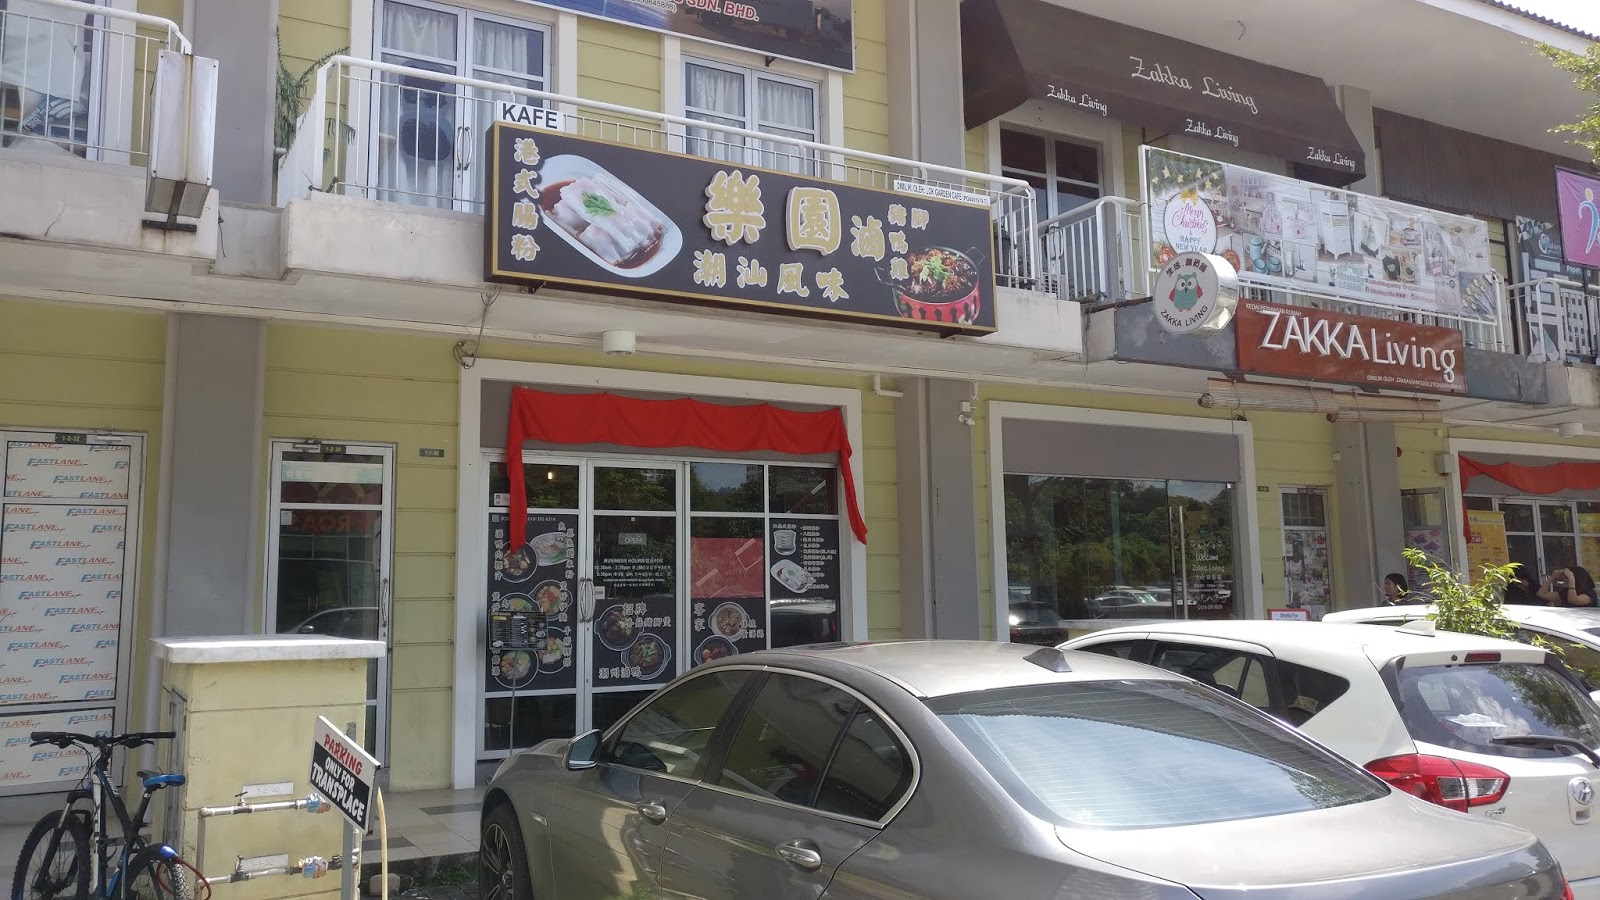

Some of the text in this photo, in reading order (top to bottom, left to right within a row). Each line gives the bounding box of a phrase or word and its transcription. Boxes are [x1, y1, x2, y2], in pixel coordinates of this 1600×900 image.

[723, 4, 759, 21] BHD.
[1129, 56, 1258, 114] Zakka Living
[1047, 84, 1108, 117] Zakka Living
[502, 102, 558, 130] KAFE
[1184, 118, 1239, 147] Zakka Living
[1306, 146, 1356, 172] Zakka Living
[702, 169, 842, 256] 樂園
[1179, 235, 1202, 245] HAPPY
[1175, 242, 1190, 251] NEW
[692, 249, 850, 302] 潮汕風味
[1160, 303, 1209, 328] ZAKKA LIVING
[1258, 308, 1456, 383] ZAKKA Living
[61, 434, 81, 442] 1-2-32
[27, 458, 82, 466] FASTLANE
[53, 475, 107, 483] FASTLANE
[66, 508, 119, 516] FASTLANE
[3, 524, 57, 532] FASTLANE
[29, 541, 84, 549] FASTLANE
[55, 558, 109, 566] FASTLANE
[18, 591, 72, 599] FASTLANE
[44, 607, 98, 616] FASTLANE
[6, 641, 61, 651] FASTLANE
[33, 657, 87, 667] FASTLANE
[58, 673, 112, 683] FASTLANE
[0, 692, 50, 701] FASTLANE
[32, 750, 86, 762] FASTLANE
[324, 733, 363, 776] PARKING
[325, 756, 356, 793] ONLY FOR
[311, 762, 365, 822] TRANSPLACE
